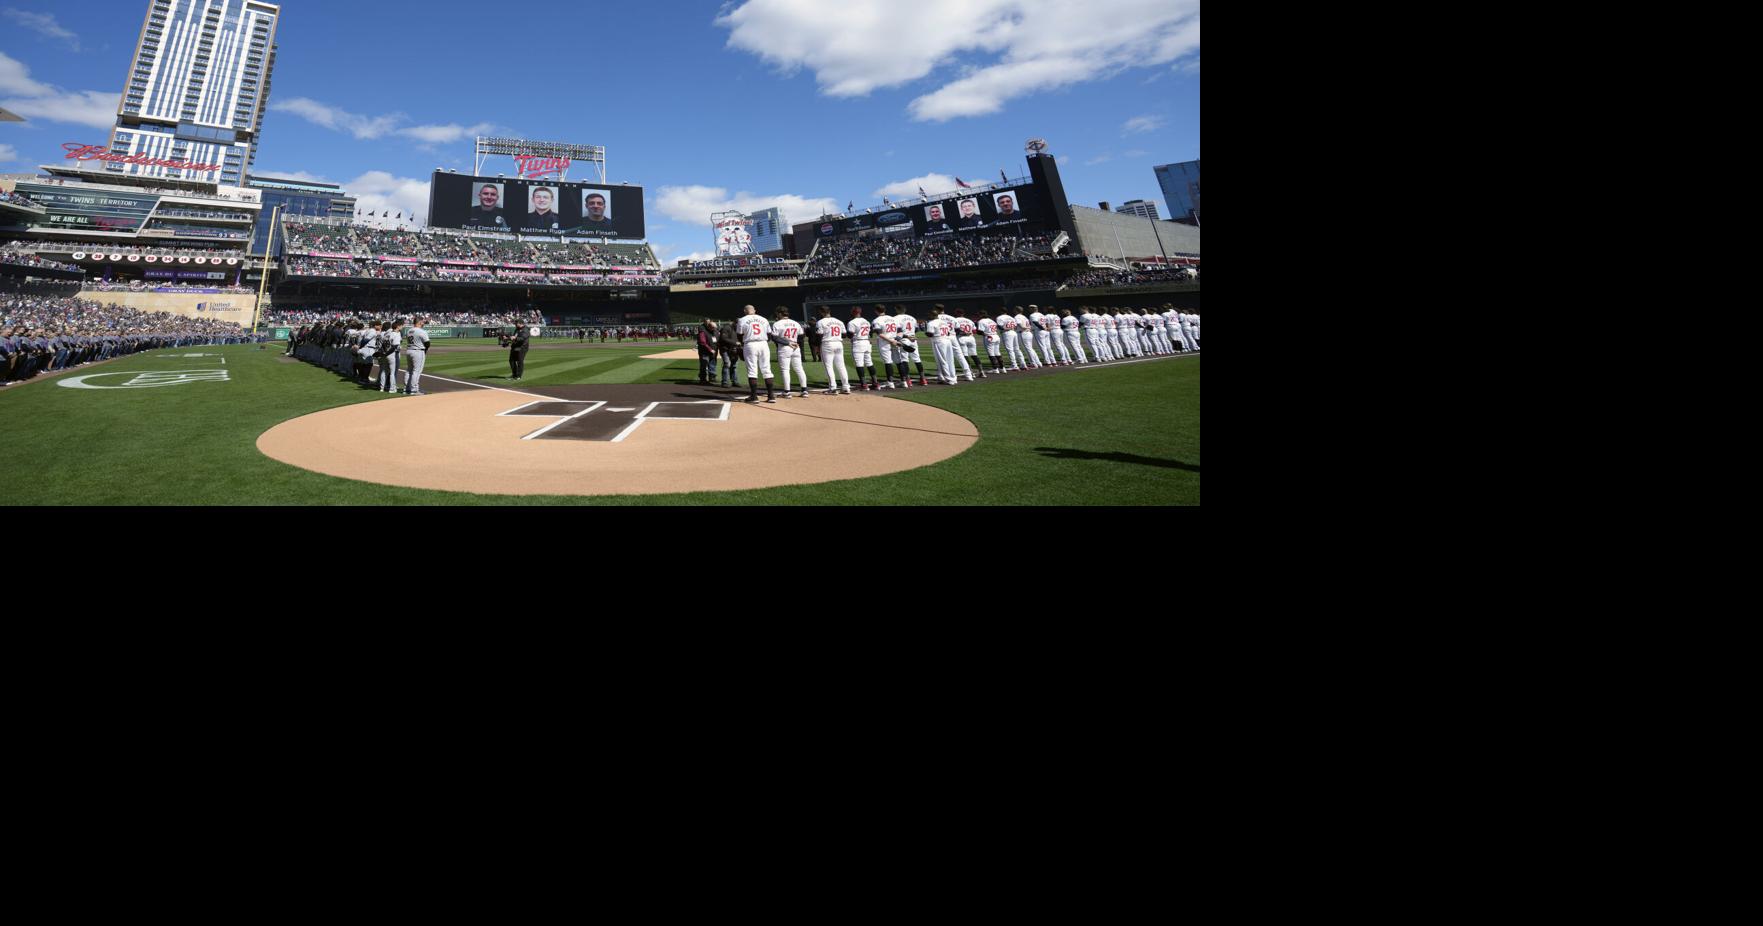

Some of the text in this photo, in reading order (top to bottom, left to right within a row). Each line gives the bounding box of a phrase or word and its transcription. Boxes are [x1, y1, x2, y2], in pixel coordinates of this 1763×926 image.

[514, 155, 571, 178] Twins
[70, 196, 95, 204] TWINS
[99, 197, 138, 207] TERRITORY
[693, 257, 785, 268] TARGET FIELD
[751, 323, 761, 335] 5
[830, 326, 841, 337] 19
[885, 323, 897, 333] 26
[905, 321, 912, 331] 4
[960, 323, 971, 334] 50
[783, 327, 798, 339] 47
